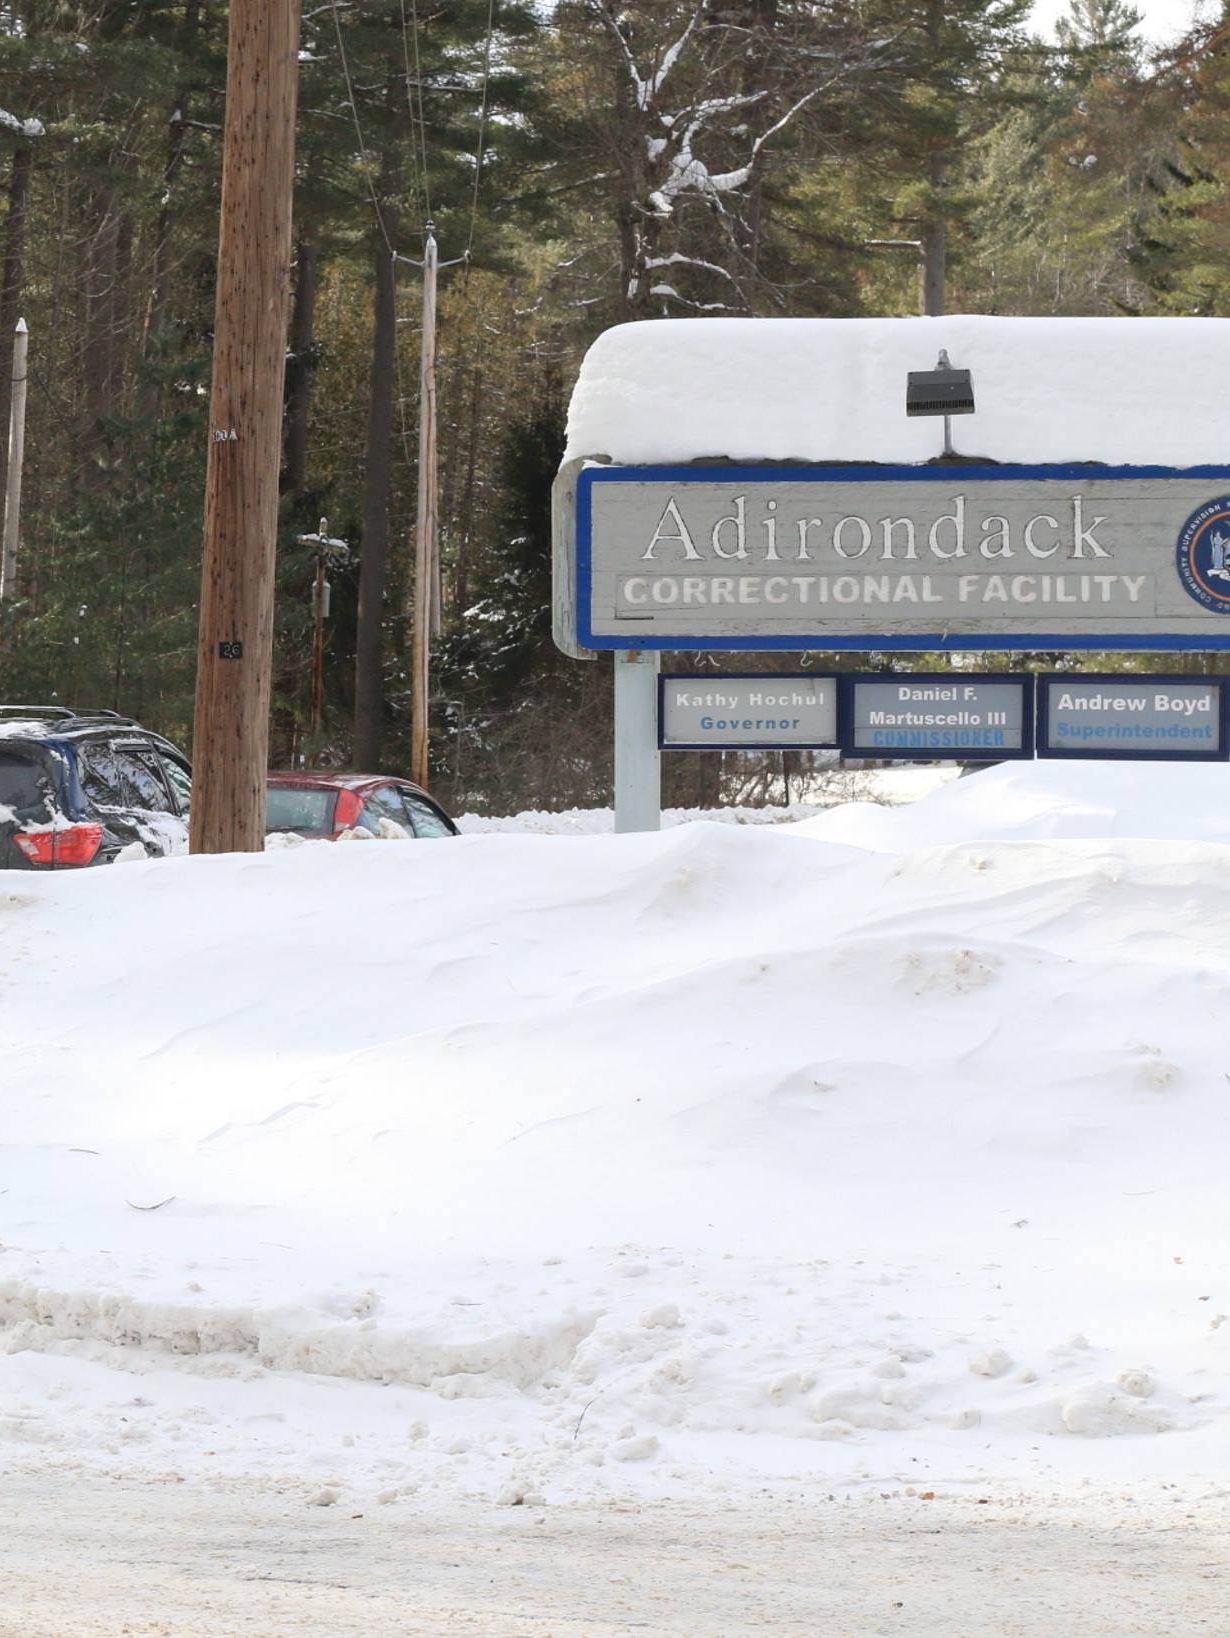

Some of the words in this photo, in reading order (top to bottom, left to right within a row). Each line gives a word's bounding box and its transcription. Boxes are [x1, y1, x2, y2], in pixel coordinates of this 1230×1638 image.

[640, 494, 1113, 560] Adirondack
[1181, 504, 1221, 552] SUPERVISION
[1181, 557, 1211, 603] COMMUNITY
[623, 575, 943, 605] CORRECTIONAL
[958, 574, 1148, 604] FACILITY
[676, 693, 738, 709] Kathy
[749, 692, 824, 706] Hochul
[898, 687, 957, 701] Daniel
[963, 688, 978, 701] F.
[1057, 693, 1147, 712] Andrew
[1154, 694, 1211, 716] Boyd
[700, 716, 800, 730] Governor
[869, 711, 981, 725] Martuscello
[987, 711, 1006, 725] III
[873, 729, 1005, 747] COMMISSIONER
[1056, 722, 1213, 740] Superintendent
